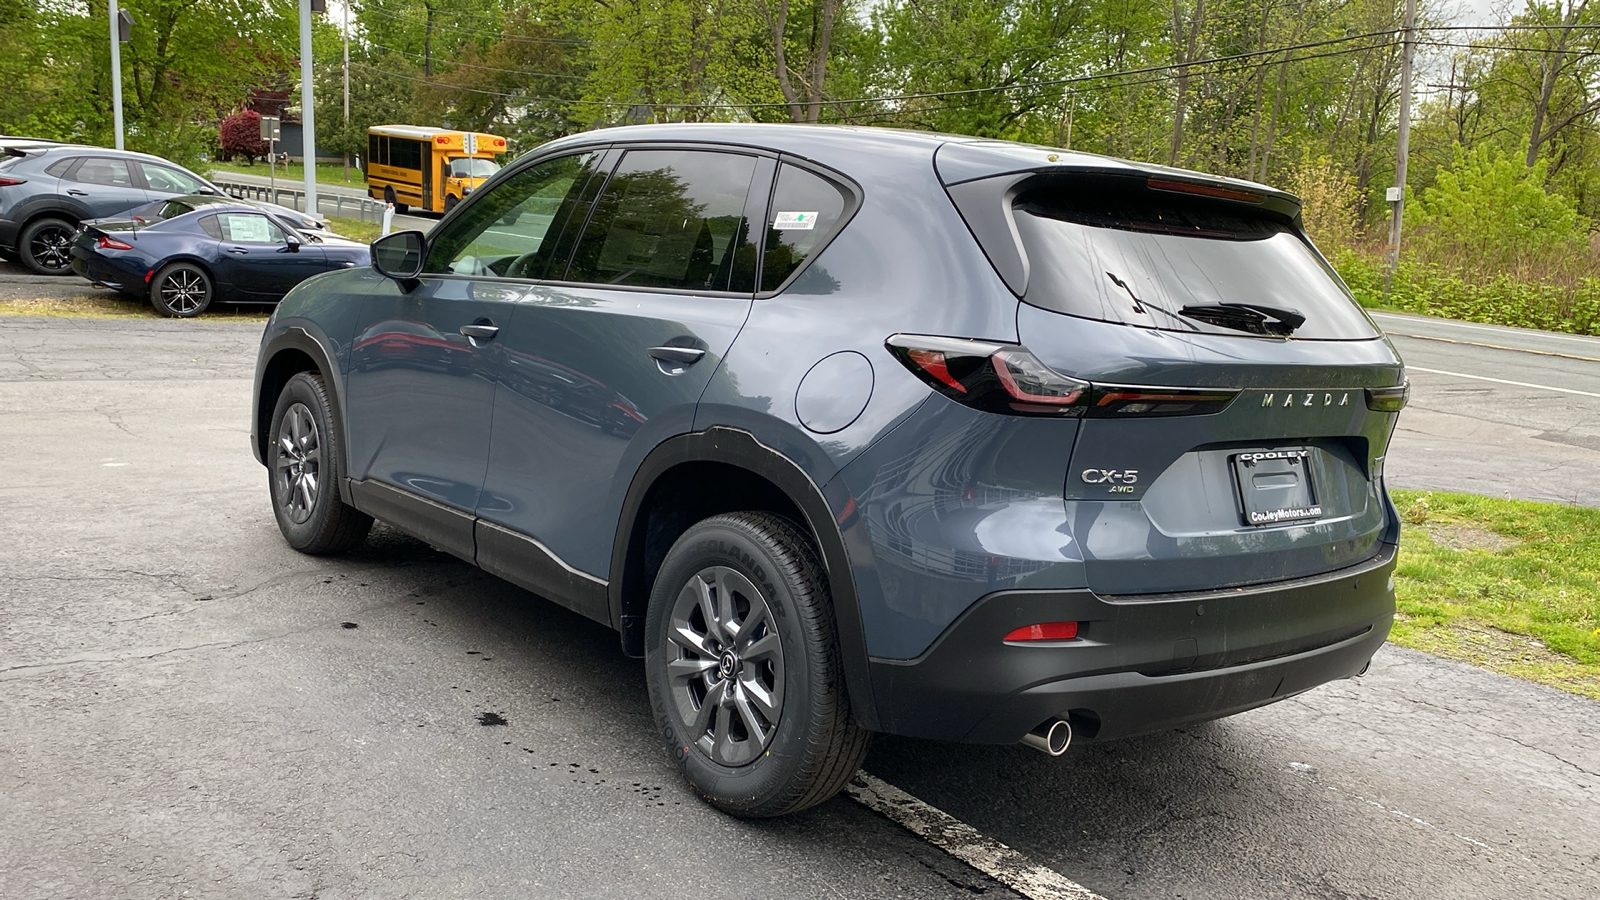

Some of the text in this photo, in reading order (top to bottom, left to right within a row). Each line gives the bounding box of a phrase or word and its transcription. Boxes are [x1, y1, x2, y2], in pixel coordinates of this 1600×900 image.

[1261, 393, 1349, 407] MAZDA
[1240, 450, 1308, 461] COOLEY
[1081, 468, 1139, 484] CX-5
[1108, 485, 1135, 493] AWD
[1251, 505, 1322, 522] CooleyMotors.com
